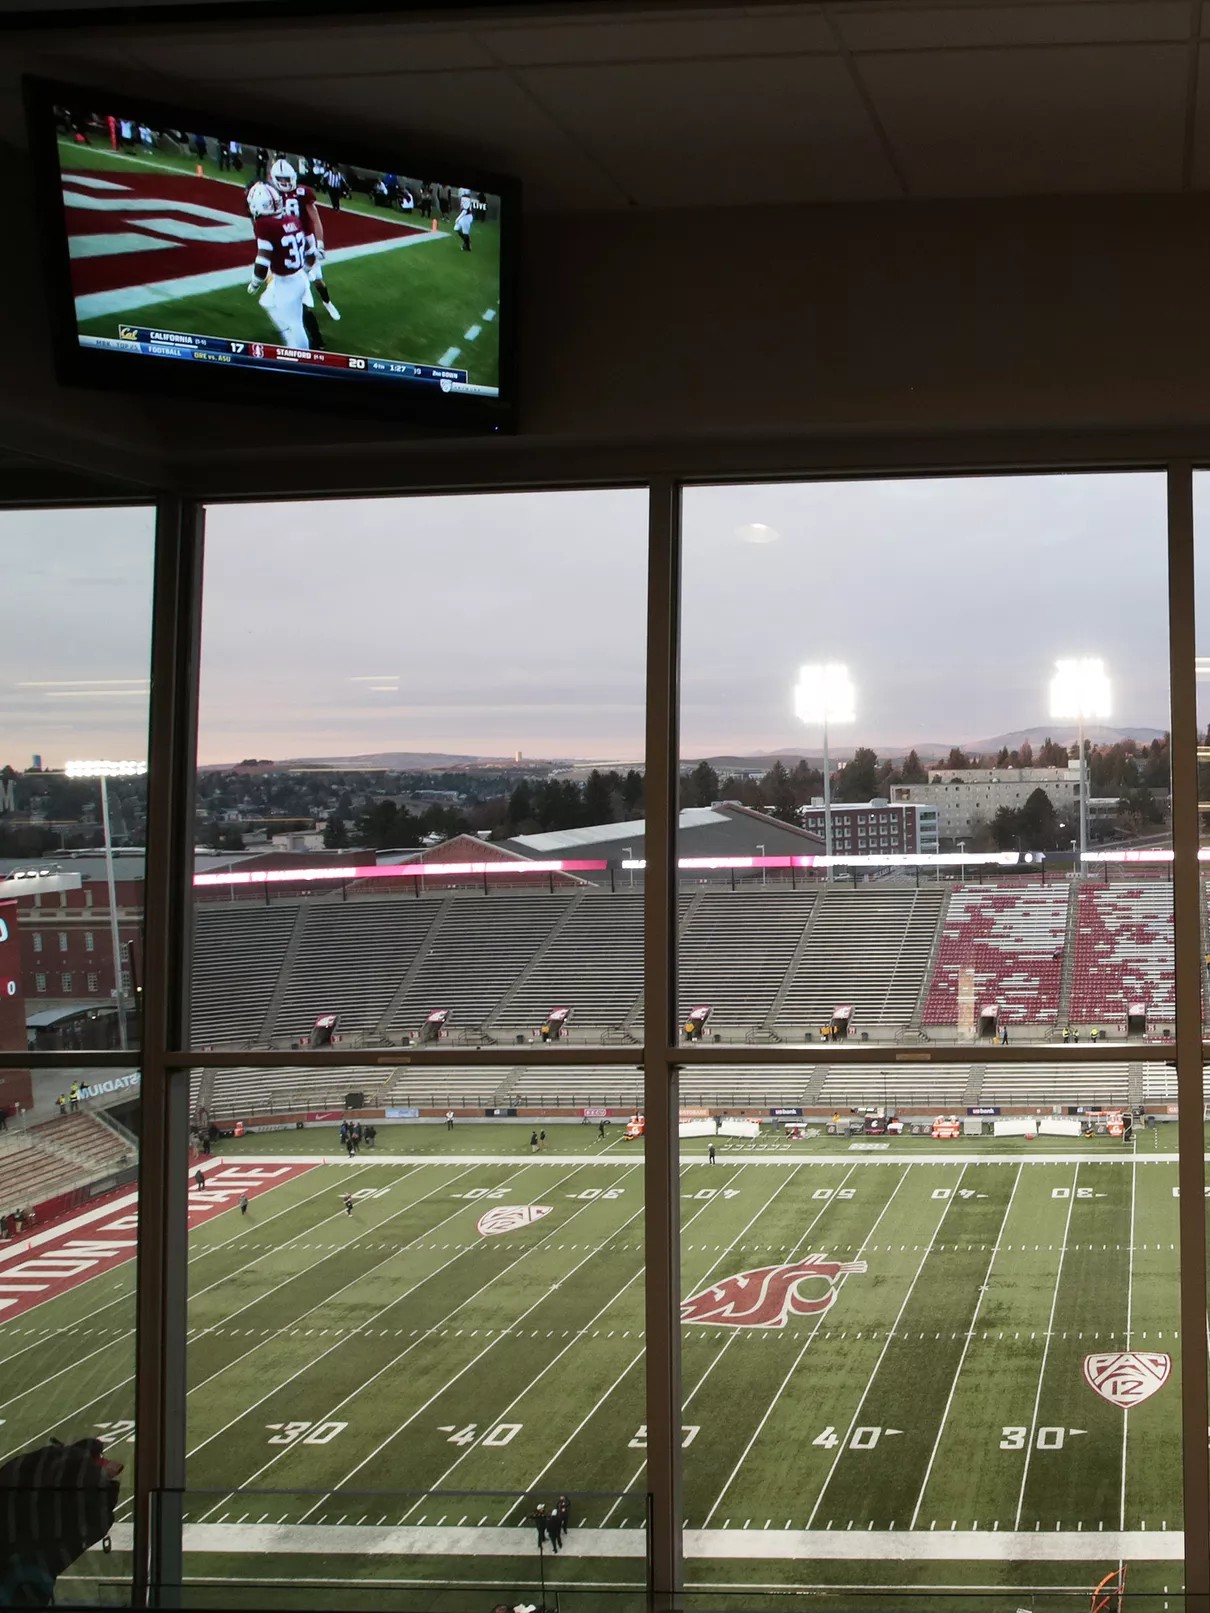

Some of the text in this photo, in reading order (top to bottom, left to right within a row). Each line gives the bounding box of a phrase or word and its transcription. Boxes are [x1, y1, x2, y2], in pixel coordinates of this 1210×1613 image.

[150, 331, 193, 344] CALIFORNIA
[148, 346, 182, 356] FOOTBALL
[230, 342, 245, 353] 17
[276, 348, 312, 359] STANFORD
[348, 358, 366, 369] 20
[390, 364, 406, 373] 1:27
[811, 1188, 857, 1199] 50
[930, 1188, 976, 1199] 40
[1051, 1187, 1094, 1198] 30
[1093, 1353, 1170, 1386] PAC
[1111, 1379, 1144, 1395] 12
[268, 1421, 348, 1445] 30
[447, 1423, 523, 1446] 40
[811, 1426, 882, 1449] 40
[1000, 1426, 1065, 1450] 30
